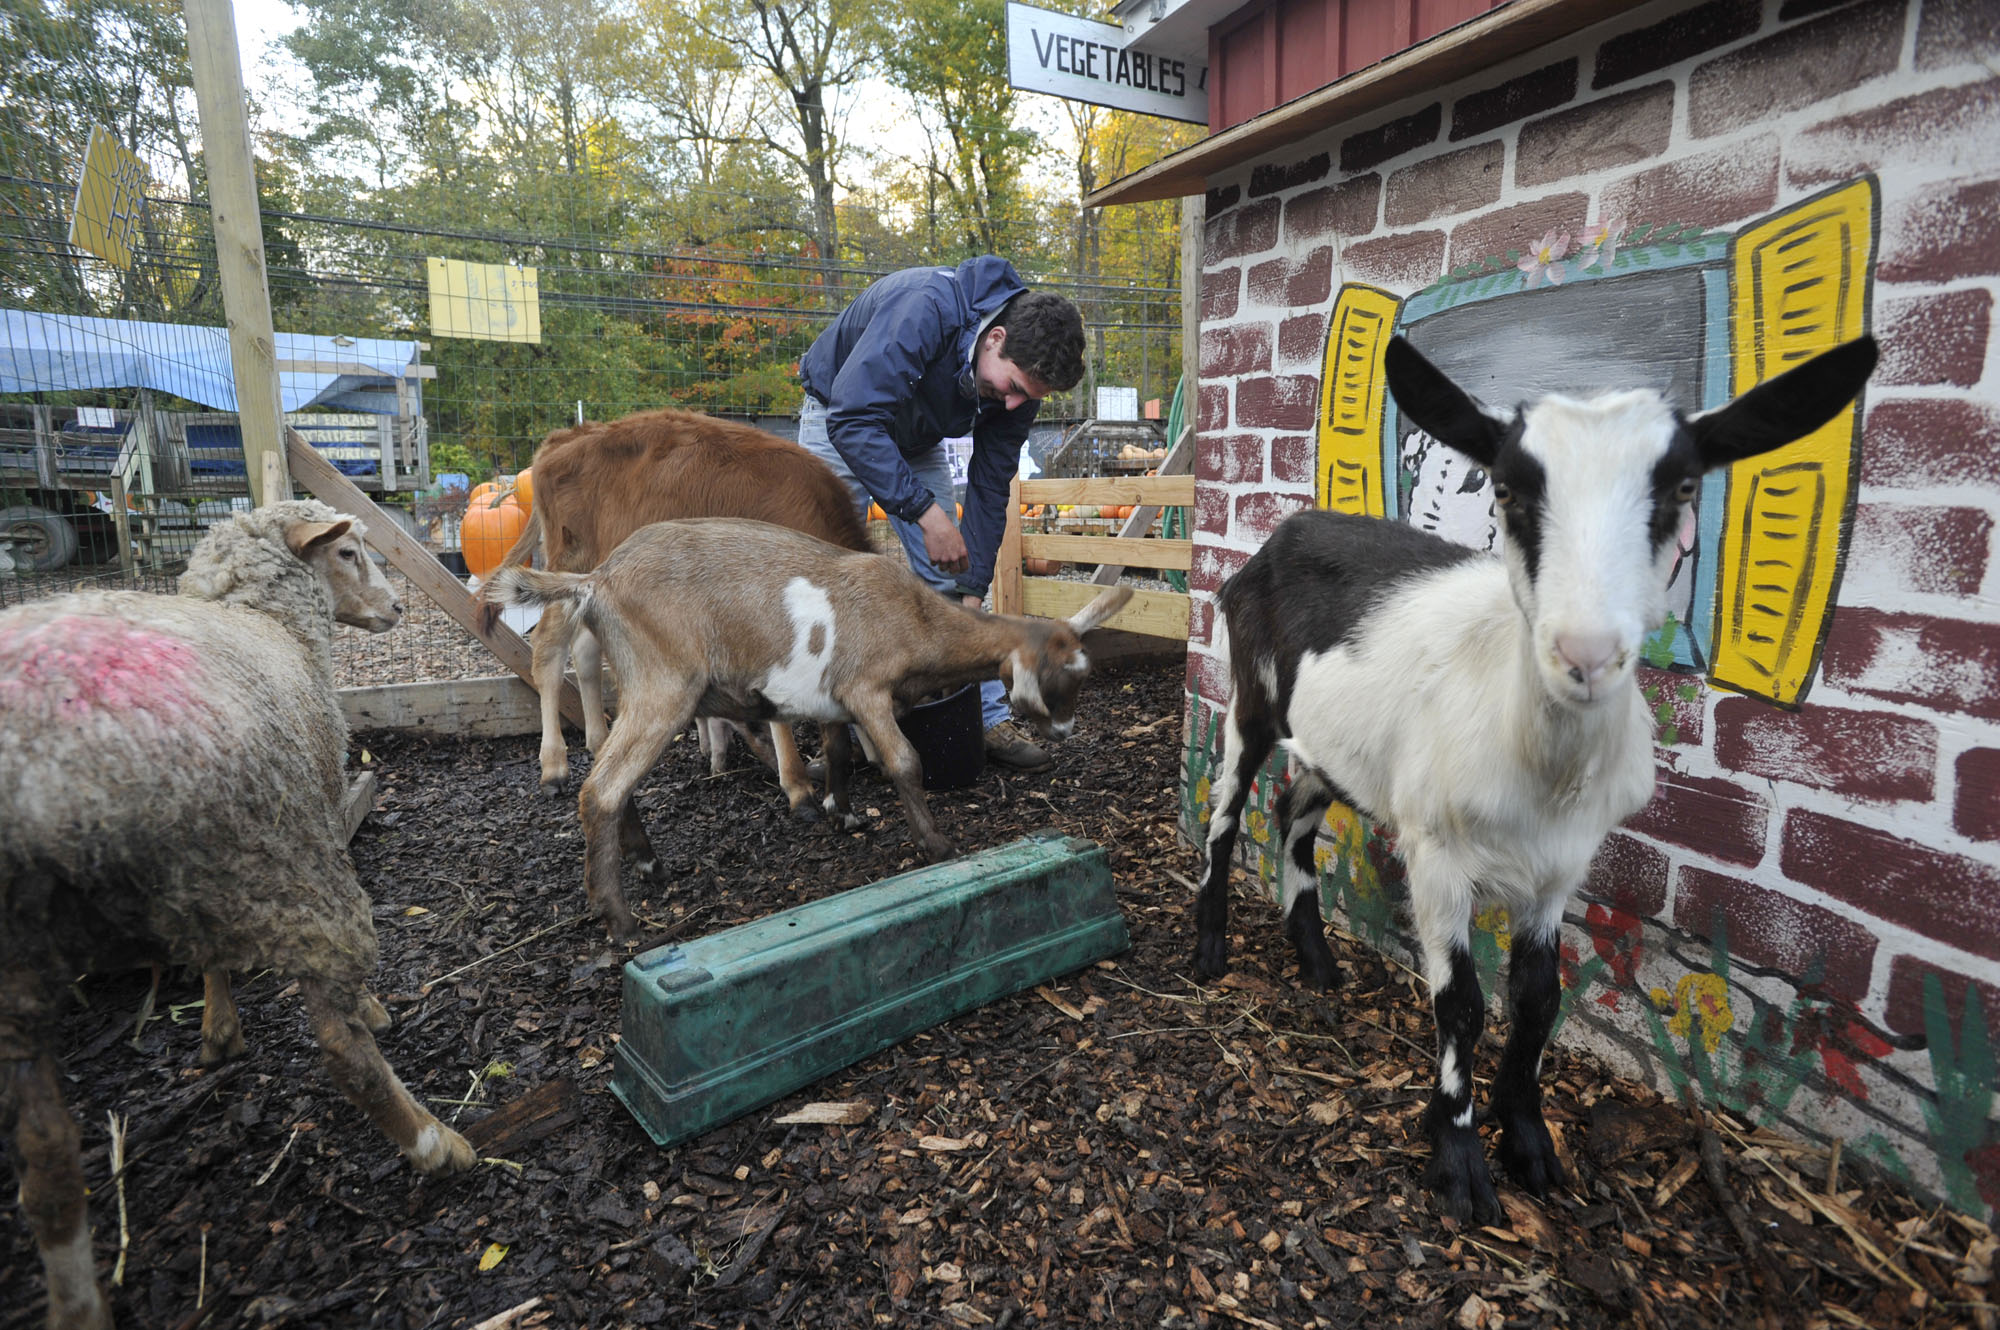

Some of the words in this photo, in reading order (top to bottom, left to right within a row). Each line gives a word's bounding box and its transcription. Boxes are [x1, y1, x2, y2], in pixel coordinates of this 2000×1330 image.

[1030, 28, 1186, 97] VEGETABLES
[324, 413, 377, 426] FARMS
[298, 429, 367, 443] AYRIDES
